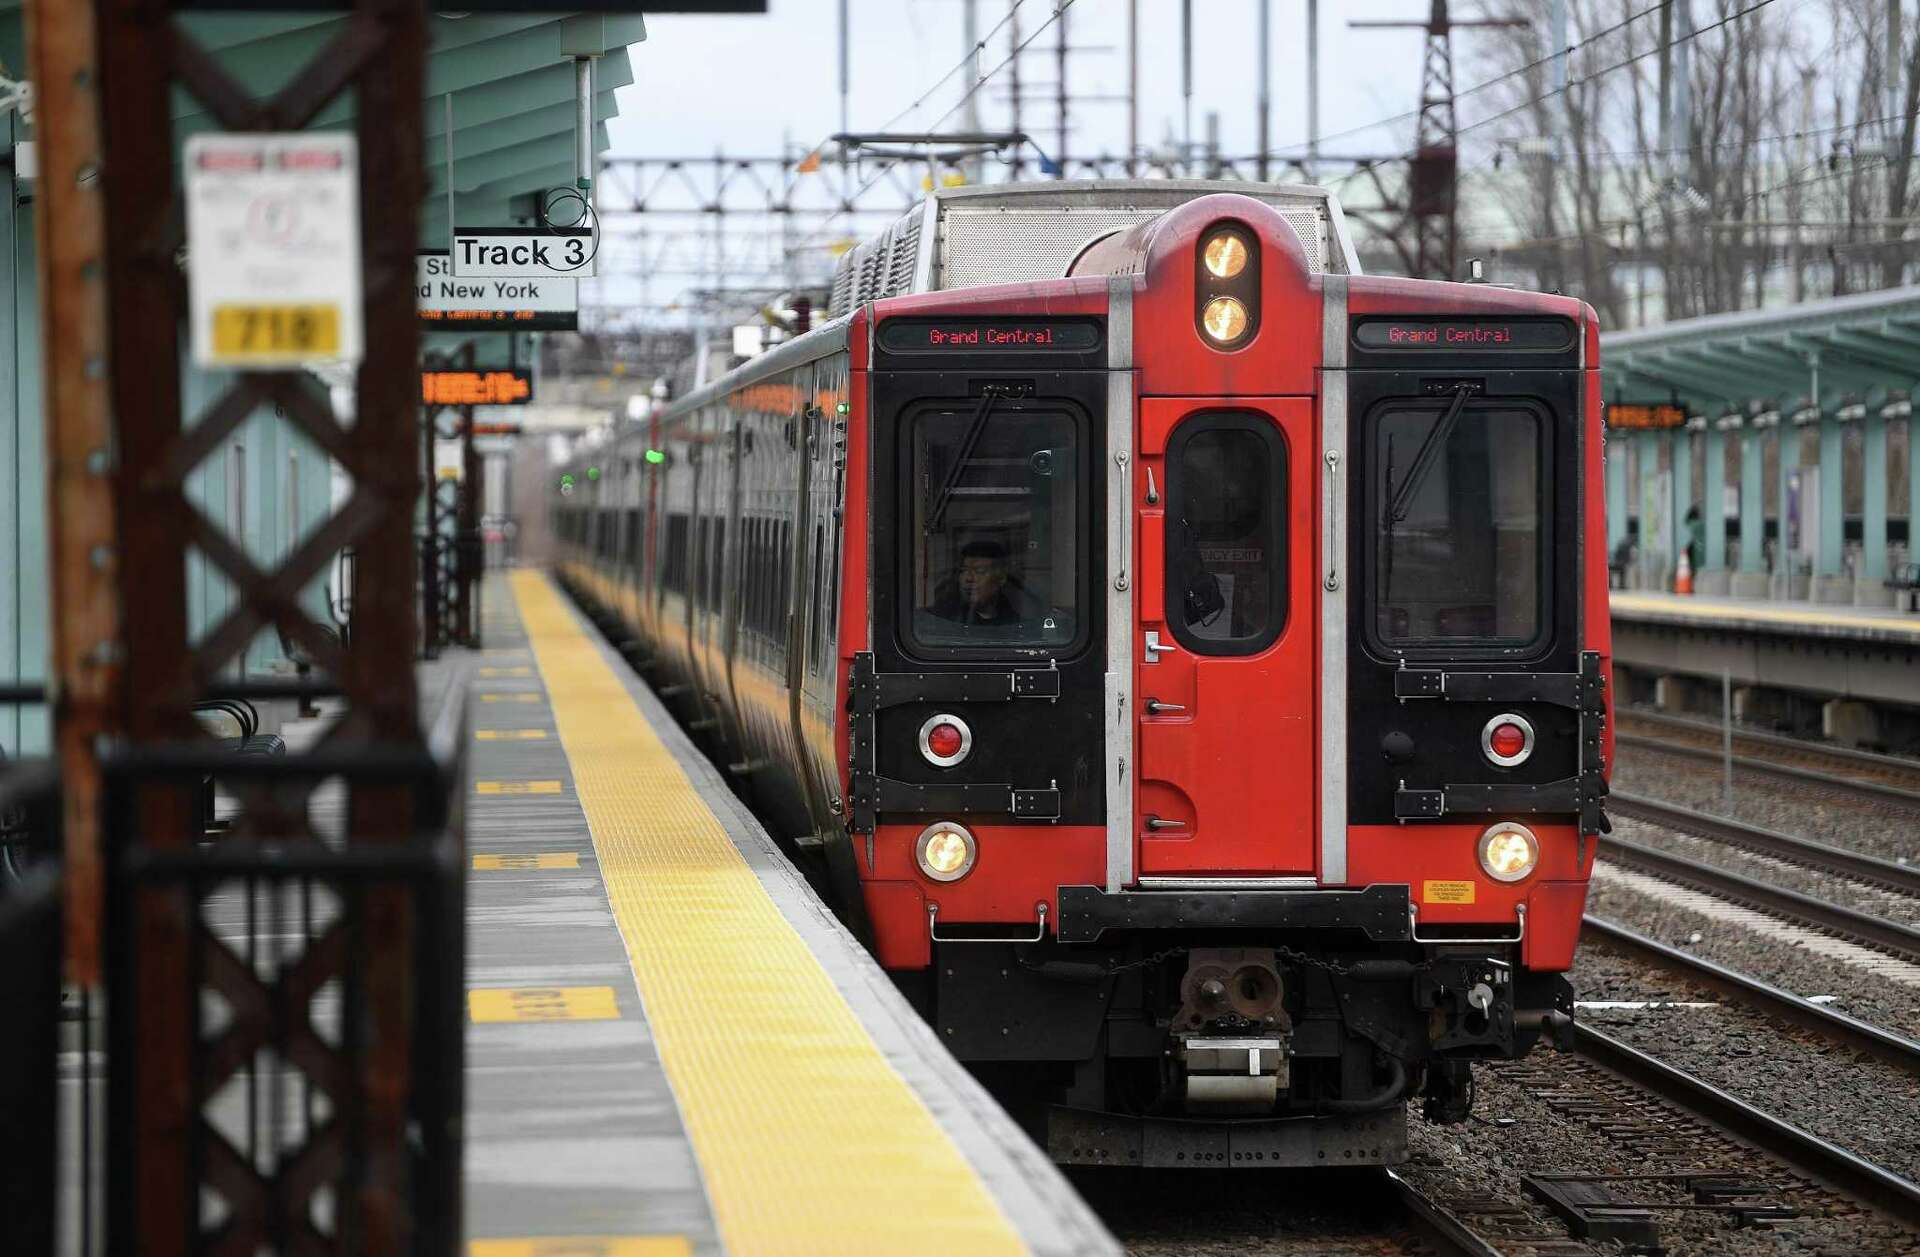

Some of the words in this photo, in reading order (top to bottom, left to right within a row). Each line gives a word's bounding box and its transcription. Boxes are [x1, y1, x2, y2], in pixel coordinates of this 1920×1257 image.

[457, 239, 550, 266] Track
[564, 238, 585, 266] 3
[441, 282, 486, 298] New
[494, 281, 540, 298] York
[929, 328, 979, 344] Grand
[986, 328, 1053, 344] Central
[1389, 327, 1437, 343] Grand
[1445, 327, 1511, 342] Central
